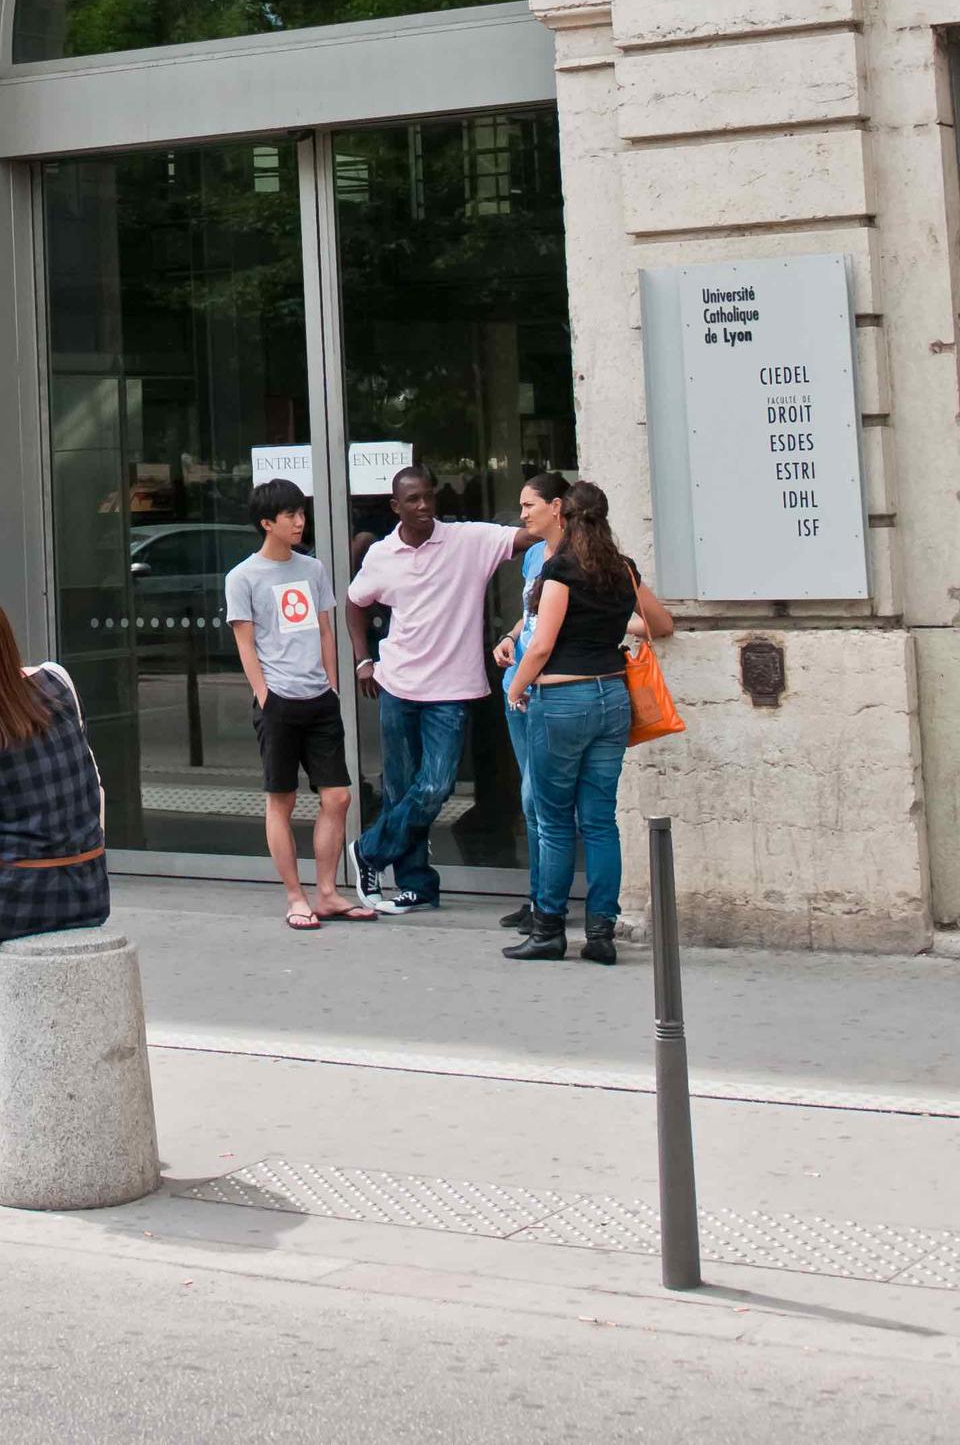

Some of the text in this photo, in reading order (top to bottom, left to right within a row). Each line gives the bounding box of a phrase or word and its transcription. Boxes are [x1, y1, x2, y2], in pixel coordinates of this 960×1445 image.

[702, 285, 755, 304] Université
[704, 306, 759, 325] Catholique
[705, 327, 752, 347] de Lyon
[760, 366, 809, 385] CIEDEL
[768, 405, 812, 423] DROIT
[770, 434, 813, 452] ESDES
[256, 456, 309, 470] ENTREE
[353, 452, 409, 466] ENTREE
[776, 462, 815, 480] ESTRI
[783, 490, 818, 508] IDHL
[798, 519, 819, 536] ISF
